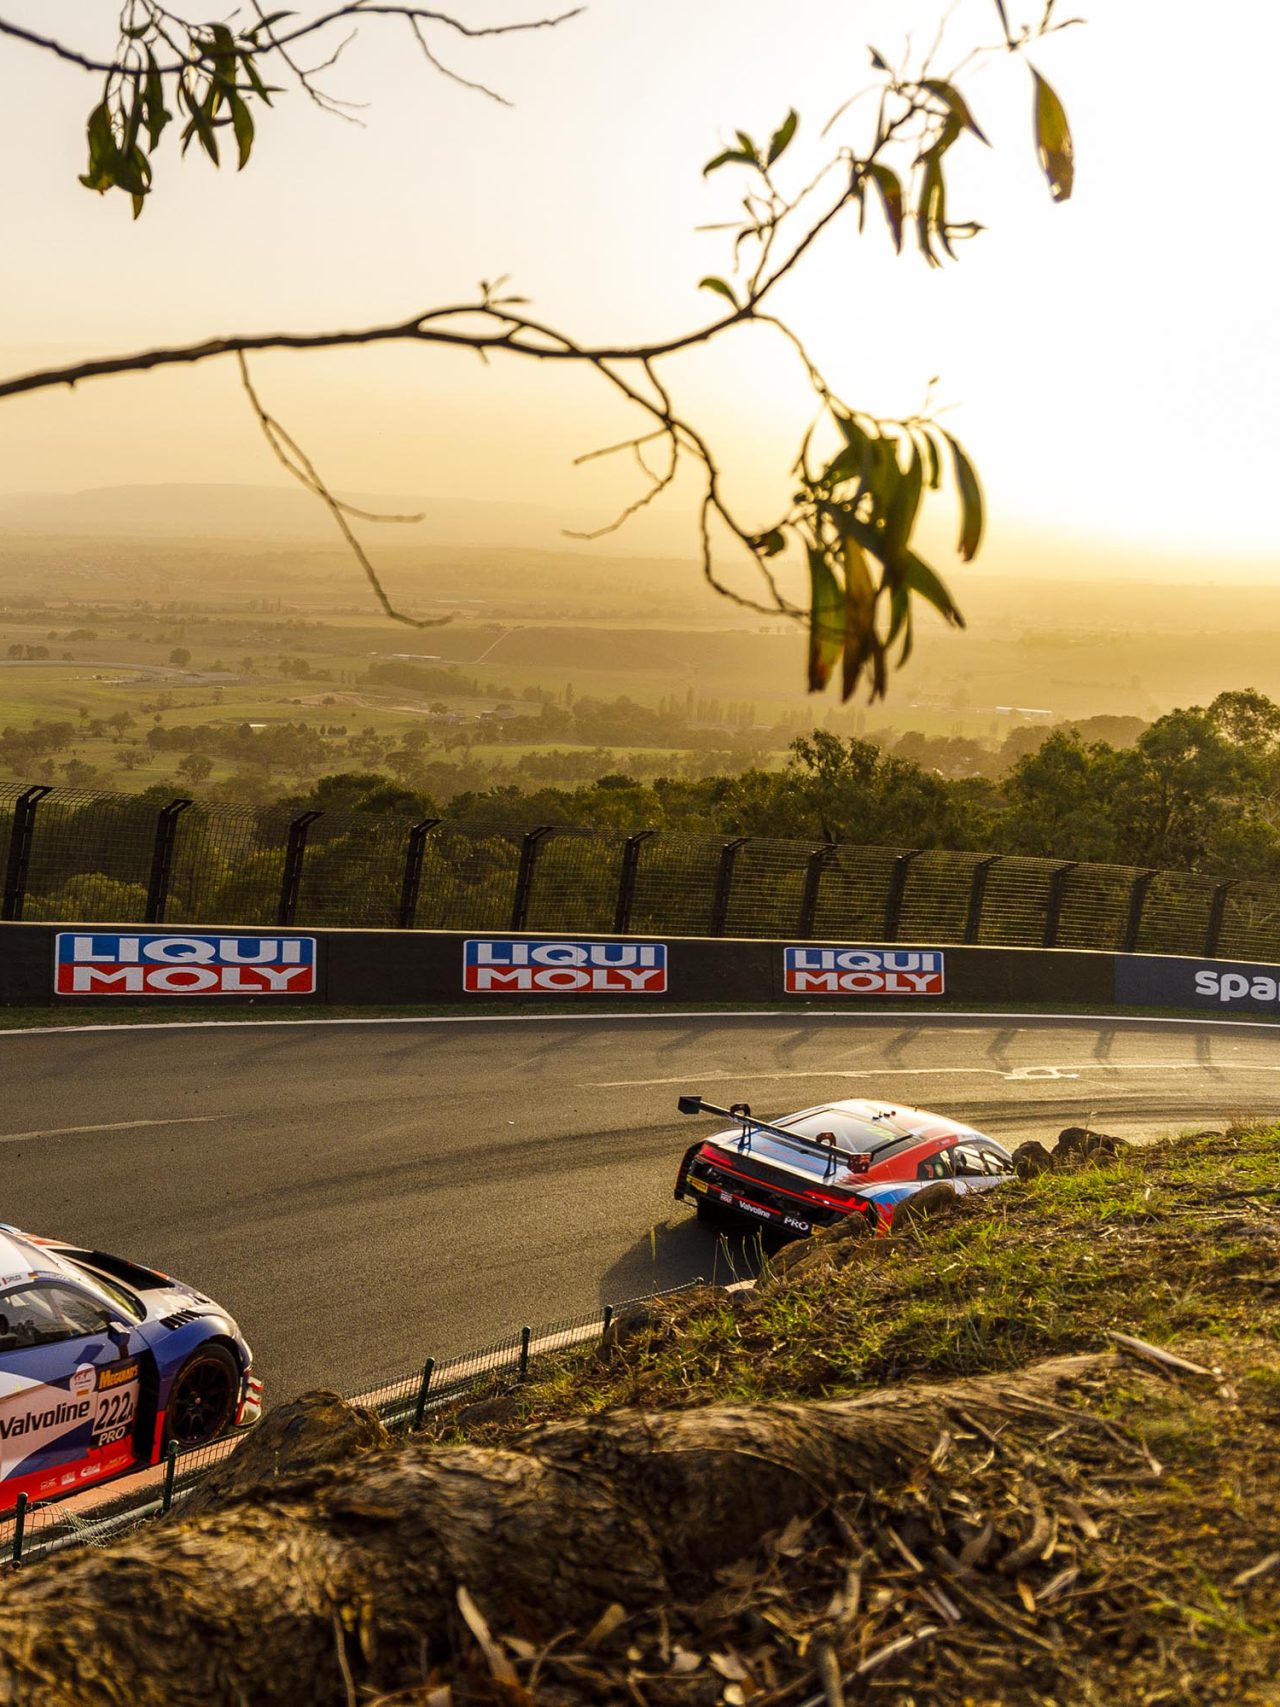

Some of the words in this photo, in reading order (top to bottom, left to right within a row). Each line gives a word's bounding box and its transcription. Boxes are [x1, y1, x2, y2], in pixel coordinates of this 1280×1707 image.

[74, 937, 301, 964] LIQUI
[477, 944, 655, 967] LIQUI
[795, 950, 934, 971] LIQUI
[73, 967, 308, 992] MOLY
[477, 968, 661, 990] MOLY
[795, 972, 939, 992] MOLY
[1195, 971, 1280, 1001] spa
[739, 1201, 771, 1219] Valvoline
[784, 1216, 809, 1231] PRO
[98, 1426, 126, 1446] PRO
